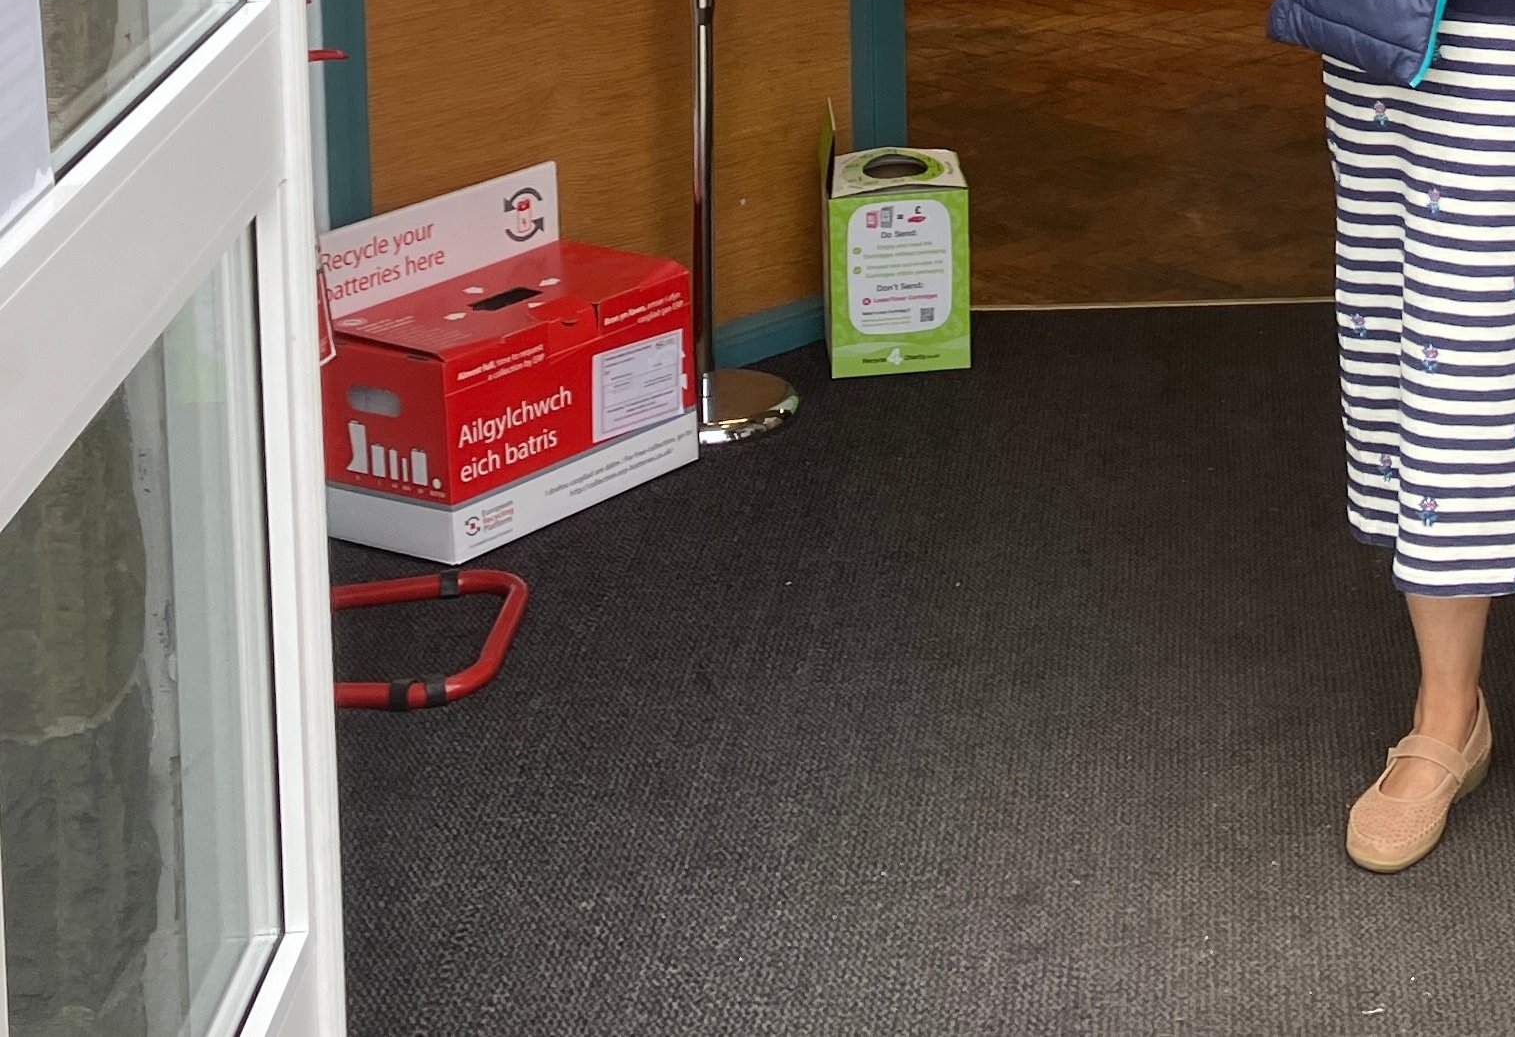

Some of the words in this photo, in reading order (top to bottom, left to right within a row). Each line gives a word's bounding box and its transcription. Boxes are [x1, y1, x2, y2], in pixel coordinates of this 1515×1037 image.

[915, 205, 922, 215] £
[320, 236, 388, 271] Recycle
[392, 223, 434, 256] your
[880, 231, 892, 239] Do
[895, 229, 917, 238] Send:
[405, 249, 446, 276] here
[876, 284, 899, 292] Don't
[458, 385, 573, 449] Ailgylchwch
[460, 449, 501, 483] eich
[505, 428, 559, 465] batris
